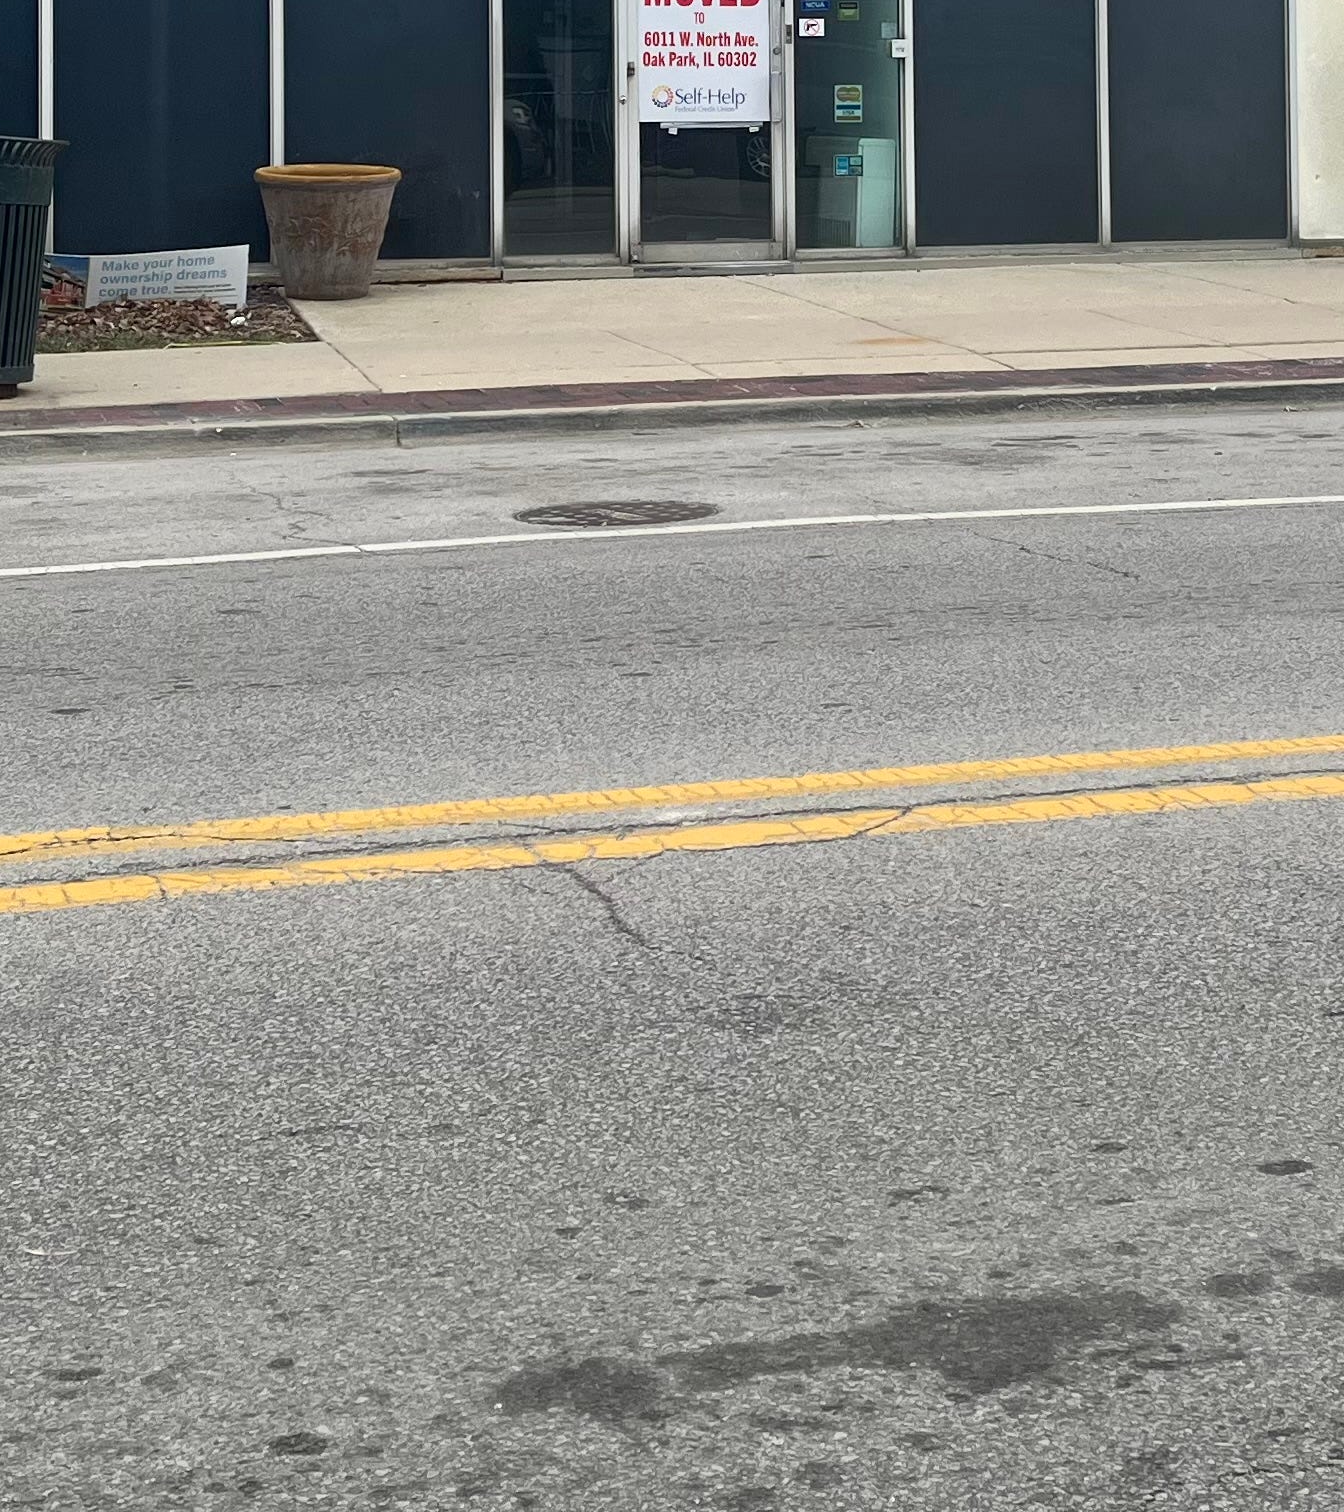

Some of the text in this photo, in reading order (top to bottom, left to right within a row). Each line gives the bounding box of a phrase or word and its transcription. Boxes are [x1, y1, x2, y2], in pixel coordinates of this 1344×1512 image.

[694, 12, 705, 24] TO
[644, 32, 759, 46] 6011 W. North Ave.
[642, 52, 757, 69] Oak Park, IL 60302
[675, 88, 745, 109] Self-Help
[102, 256, 215, 272] Make your home
[100, 268, 227, 285] ownership dreams
[98, 287, 138, 297] come
[142, 285, 172, 296] true.
